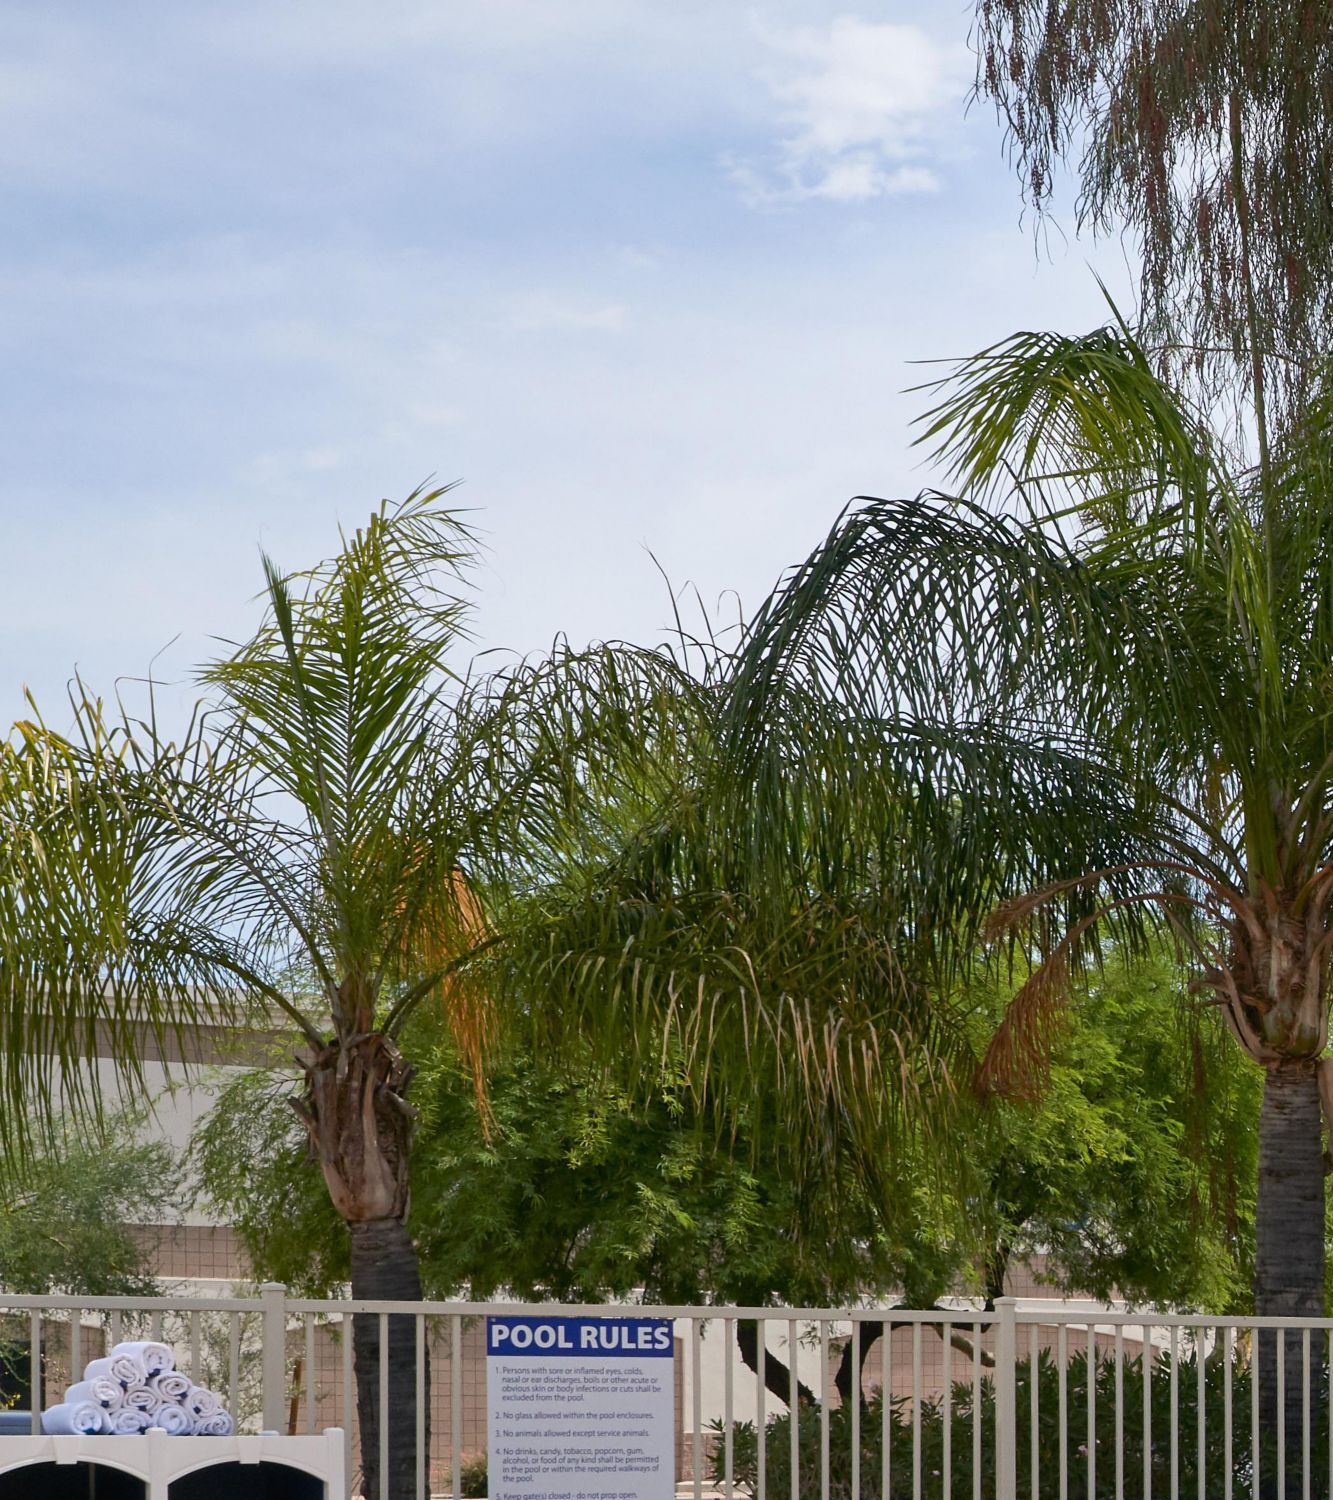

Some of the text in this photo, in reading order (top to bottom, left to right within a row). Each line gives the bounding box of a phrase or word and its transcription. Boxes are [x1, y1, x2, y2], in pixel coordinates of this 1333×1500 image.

[491, 1324, 671, 1350] POOL RULES
[502, 1366, 530, 1375] Persons
[531, 1367, 547, 1375] with
[574, 1366, 605, 1375] inflamed
[583, 1376, 600, 1384] boils
[610, 1376, 629, 1384] other
[502, 1385, 530, 1393] obvious
[531, 1385, 546, 1393] skin
[556, 1385, 575, 1394] body
[575, 1385, 610, 1393] infections
[635, 1385, 651, 1393] shall
[515, 1412, 533, 1421] glass
[534, 1411, 562, 1419] allowed
[599, 1411, 615, 1420] pool
[515, 1429, 542, 1437] animals
[543, 1429, 571, 1437] allowed
[572, 1430, 596, 1438] except
[540, 1456, 557, 1464] food
[581, 1456, 597, 1464] kind
[625, 1456, 660, 1464] permitted
[524, 1466, 541, 1474] pool
[588, 1465, 617, 1474] required
[618, 1465, 651, 1474] walkways
[503, 1492, 522, 1500] Keep
[548, 1492, 571, 1500] closed
[600, 1492, 617, 1500] prop
